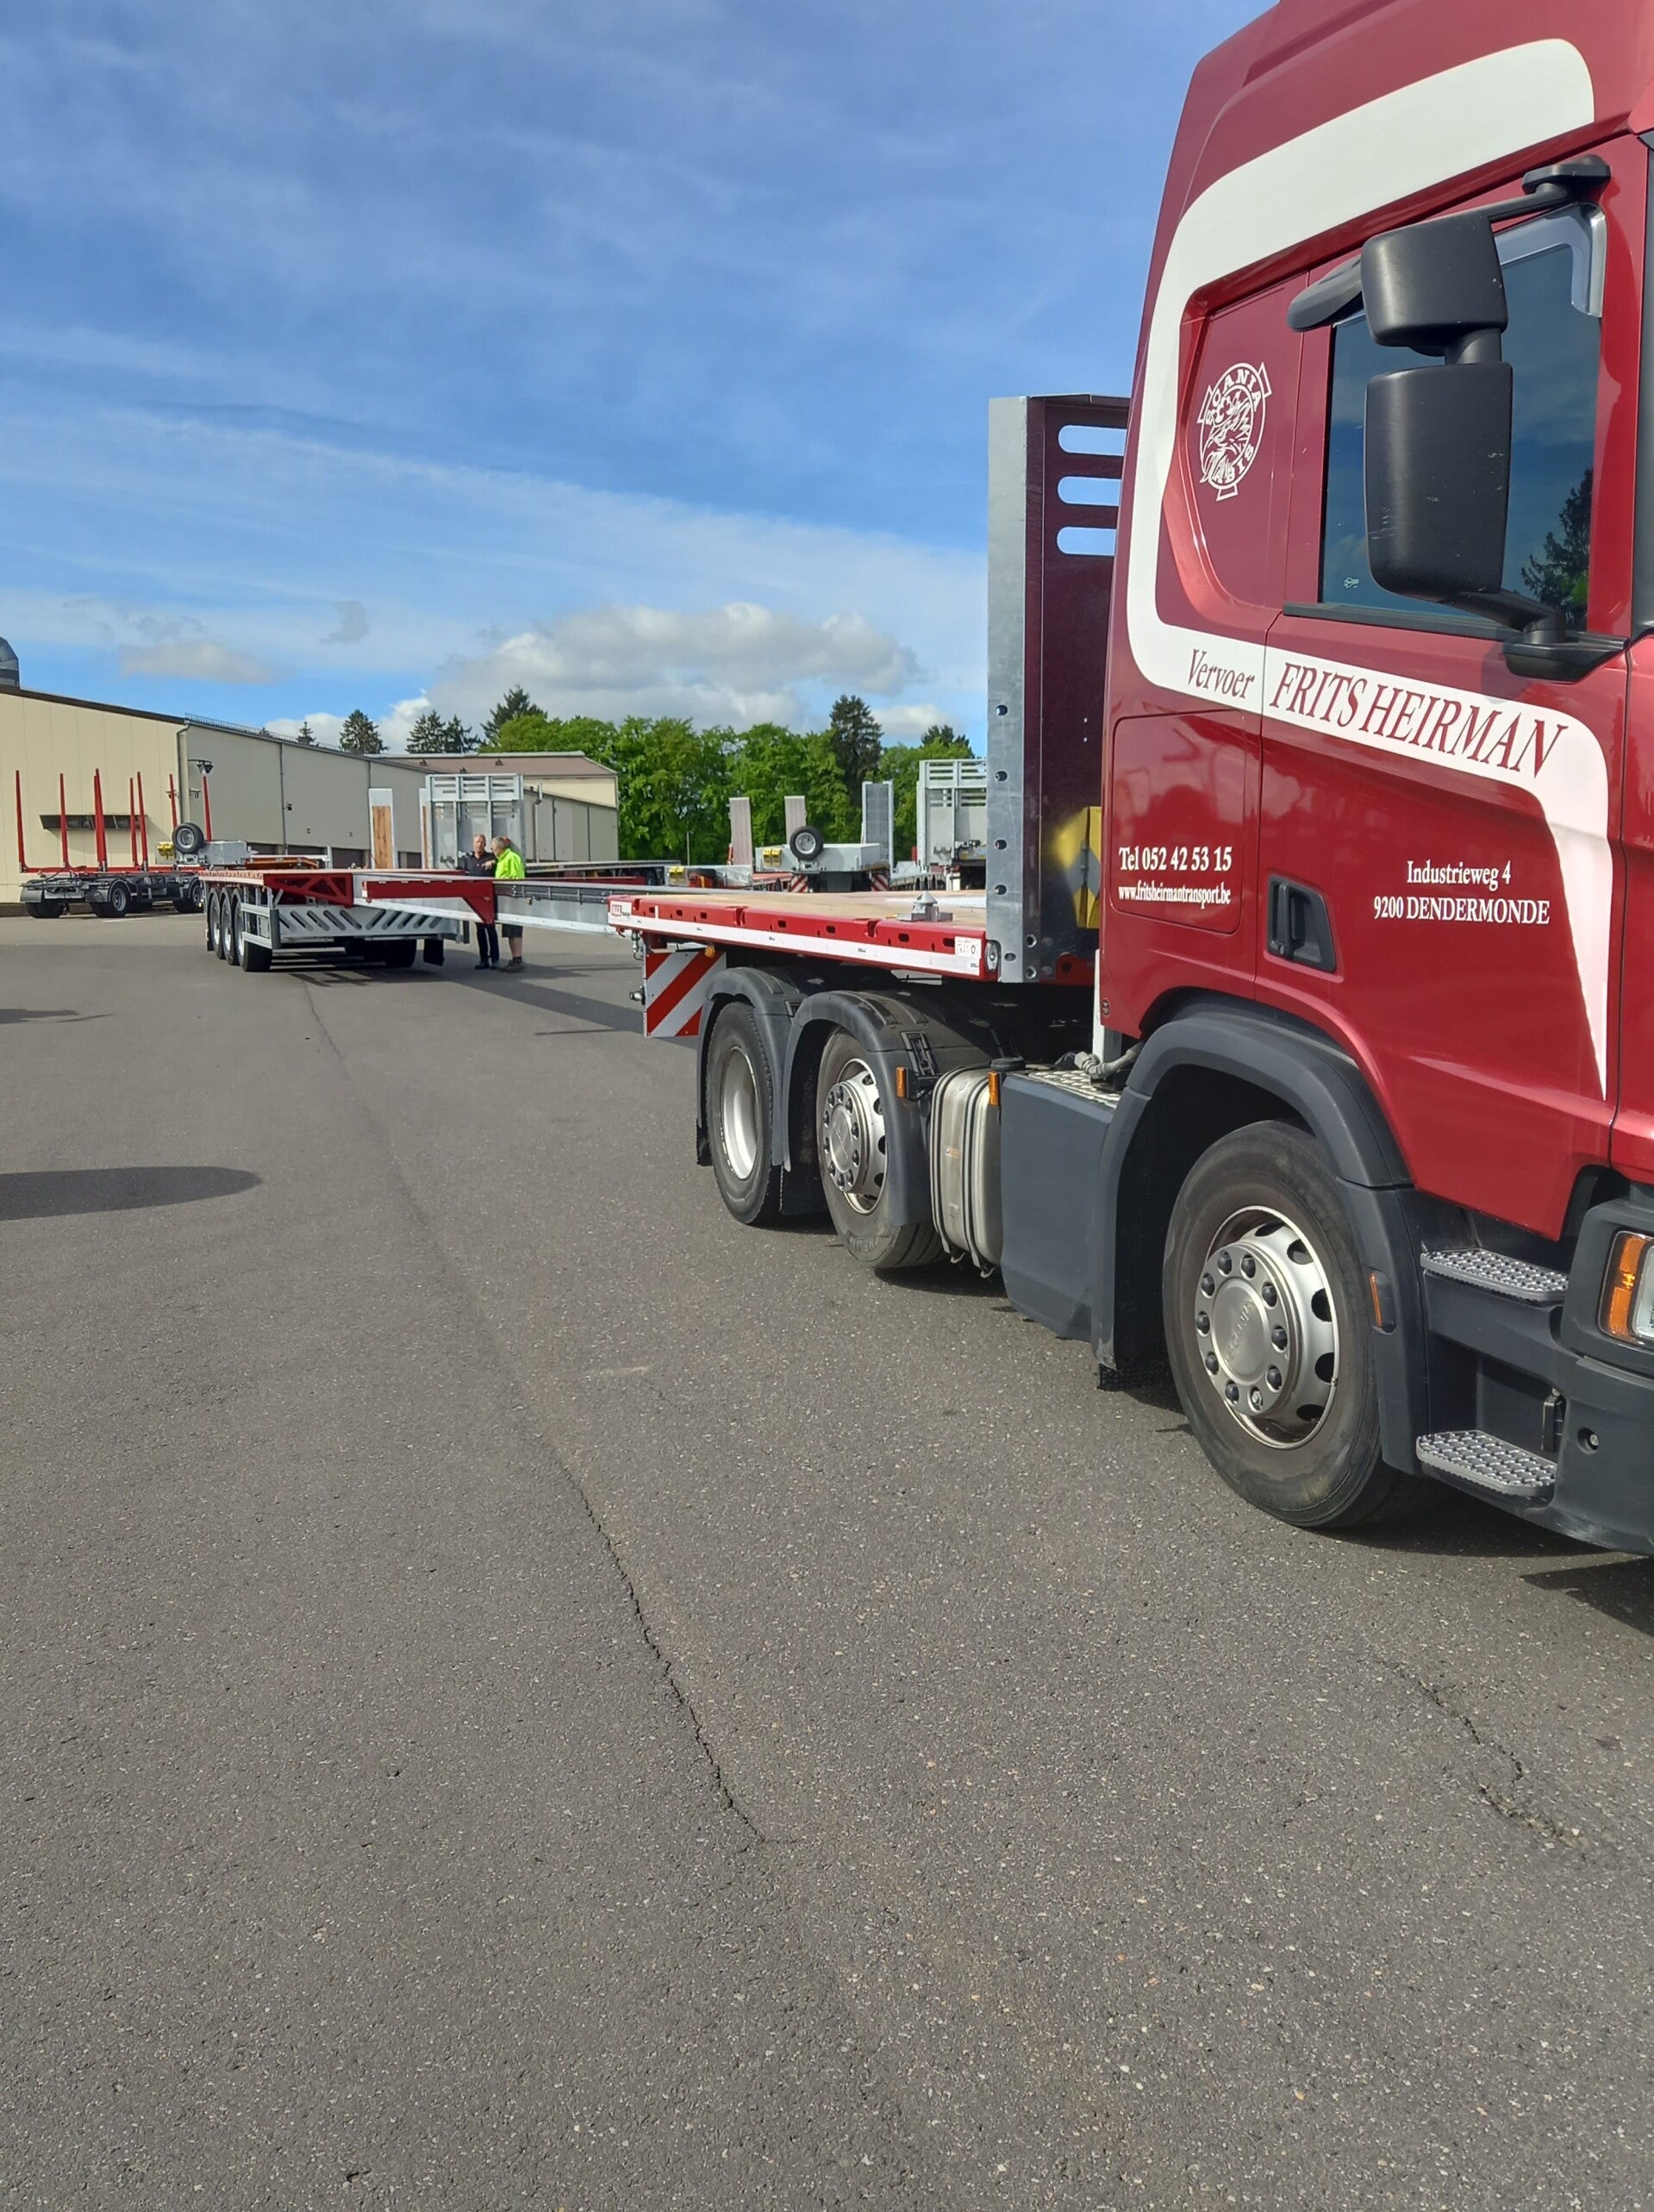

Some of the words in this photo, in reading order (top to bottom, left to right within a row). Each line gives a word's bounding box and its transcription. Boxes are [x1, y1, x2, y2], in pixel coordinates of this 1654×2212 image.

[1188, 648, 1255, 699] Vervoer
[1269, 662, 1368, 728] FRITS
[1358, 684, 1569, 778] HEIRMAN
[1118, 846, 1139, 871] Tel
[1141, 847, 1167, 871] 052
[1170, 846, 1188, 872] 42
[1190, 846, 1209, 872] 53
[1214, 846, 1233, 872] 15
[1407, 859, 1499, 891] Industrieweg
[1501, 860, 1511, 884] 4
[1118, 879, 1231, 909] www.fritsheirmantransport.be
[1373, 896, 1404, 920] 9200
[1406, 897, 1551, 925] DENDERMONDE
